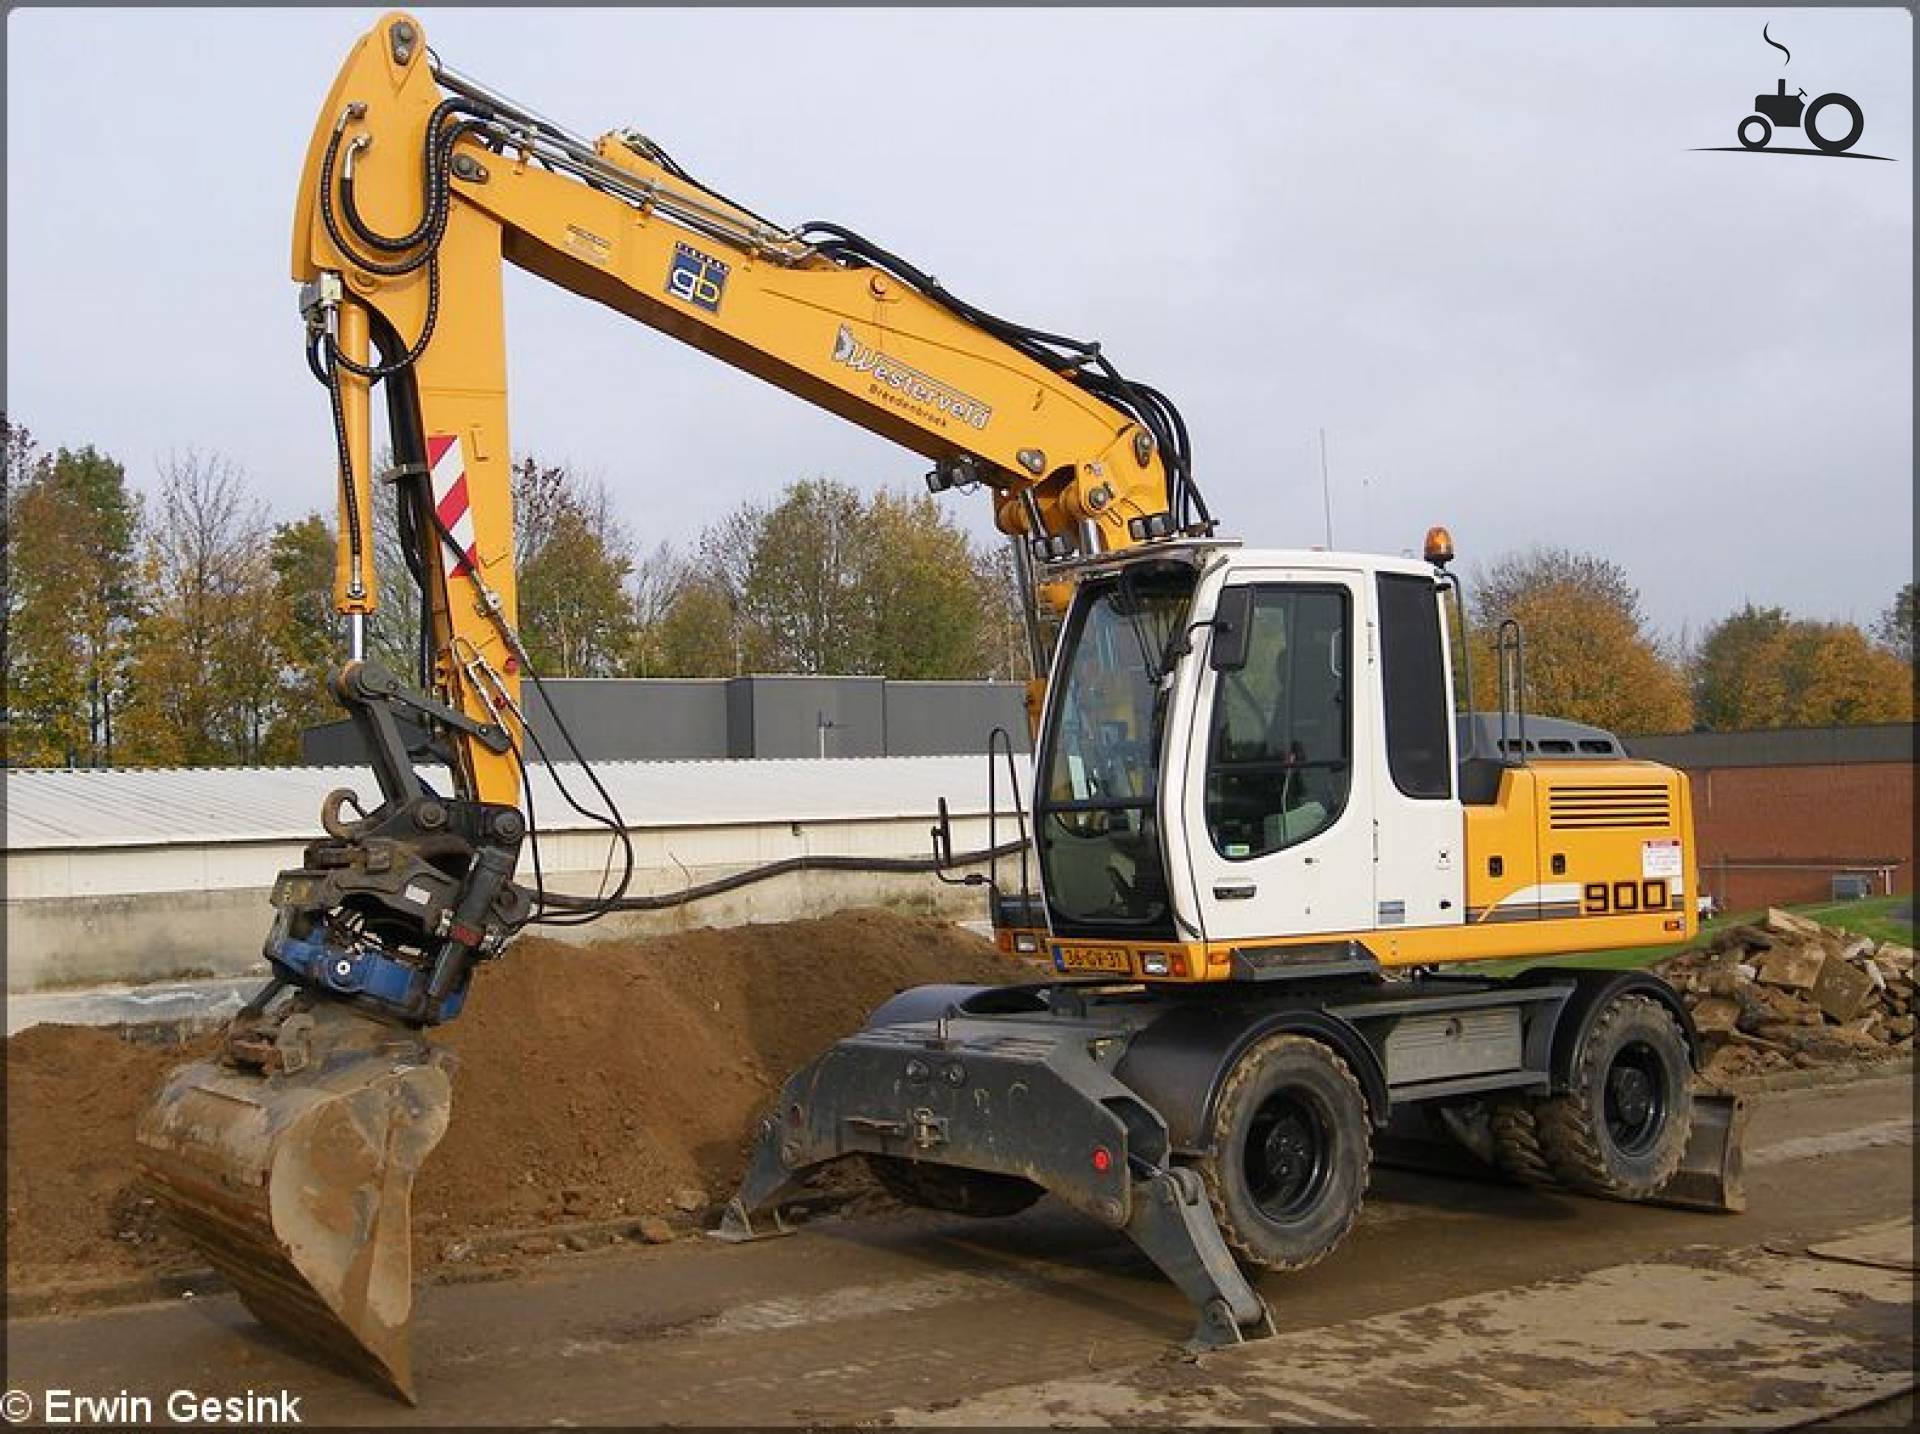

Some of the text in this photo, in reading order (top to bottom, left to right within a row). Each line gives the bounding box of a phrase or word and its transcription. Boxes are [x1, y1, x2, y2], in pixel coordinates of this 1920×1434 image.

[670, 262, 720, 302] gb
[848, 338, 992, 430] Westerveld
[1585, 880, 1667, 912] 900
